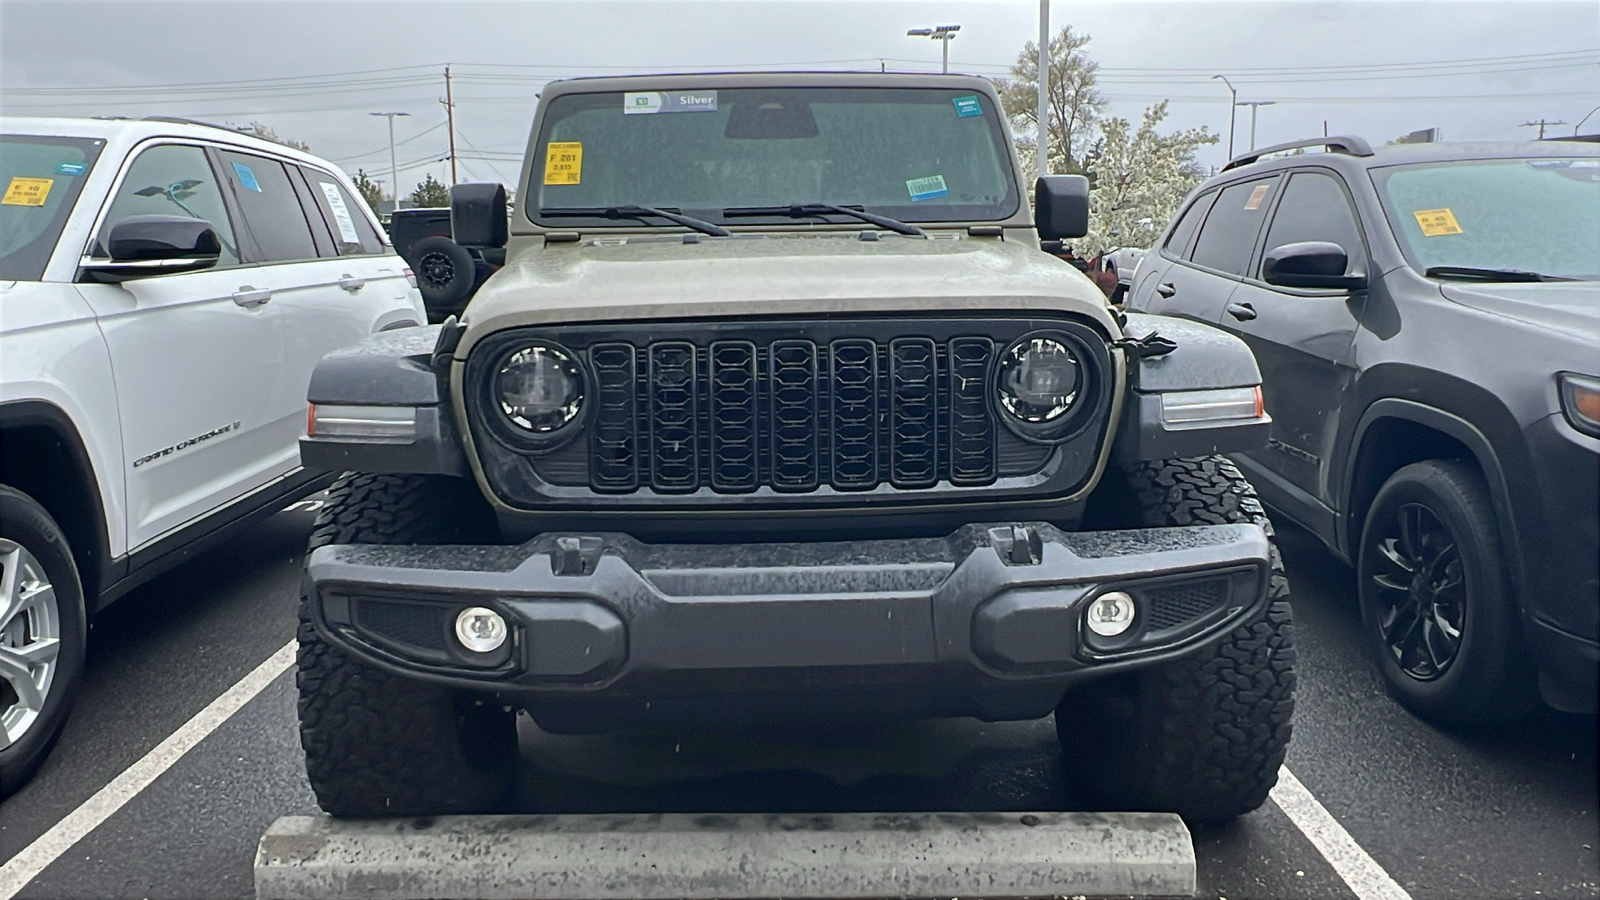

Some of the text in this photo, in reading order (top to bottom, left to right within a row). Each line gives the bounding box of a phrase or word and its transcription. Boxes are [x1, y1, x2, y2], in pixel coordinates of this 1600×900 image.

[680, 95, 713, 104] Silver
[560, 154, 576, 162] 201
[133, 424, 231, 468] GRAND CHEROKEE
